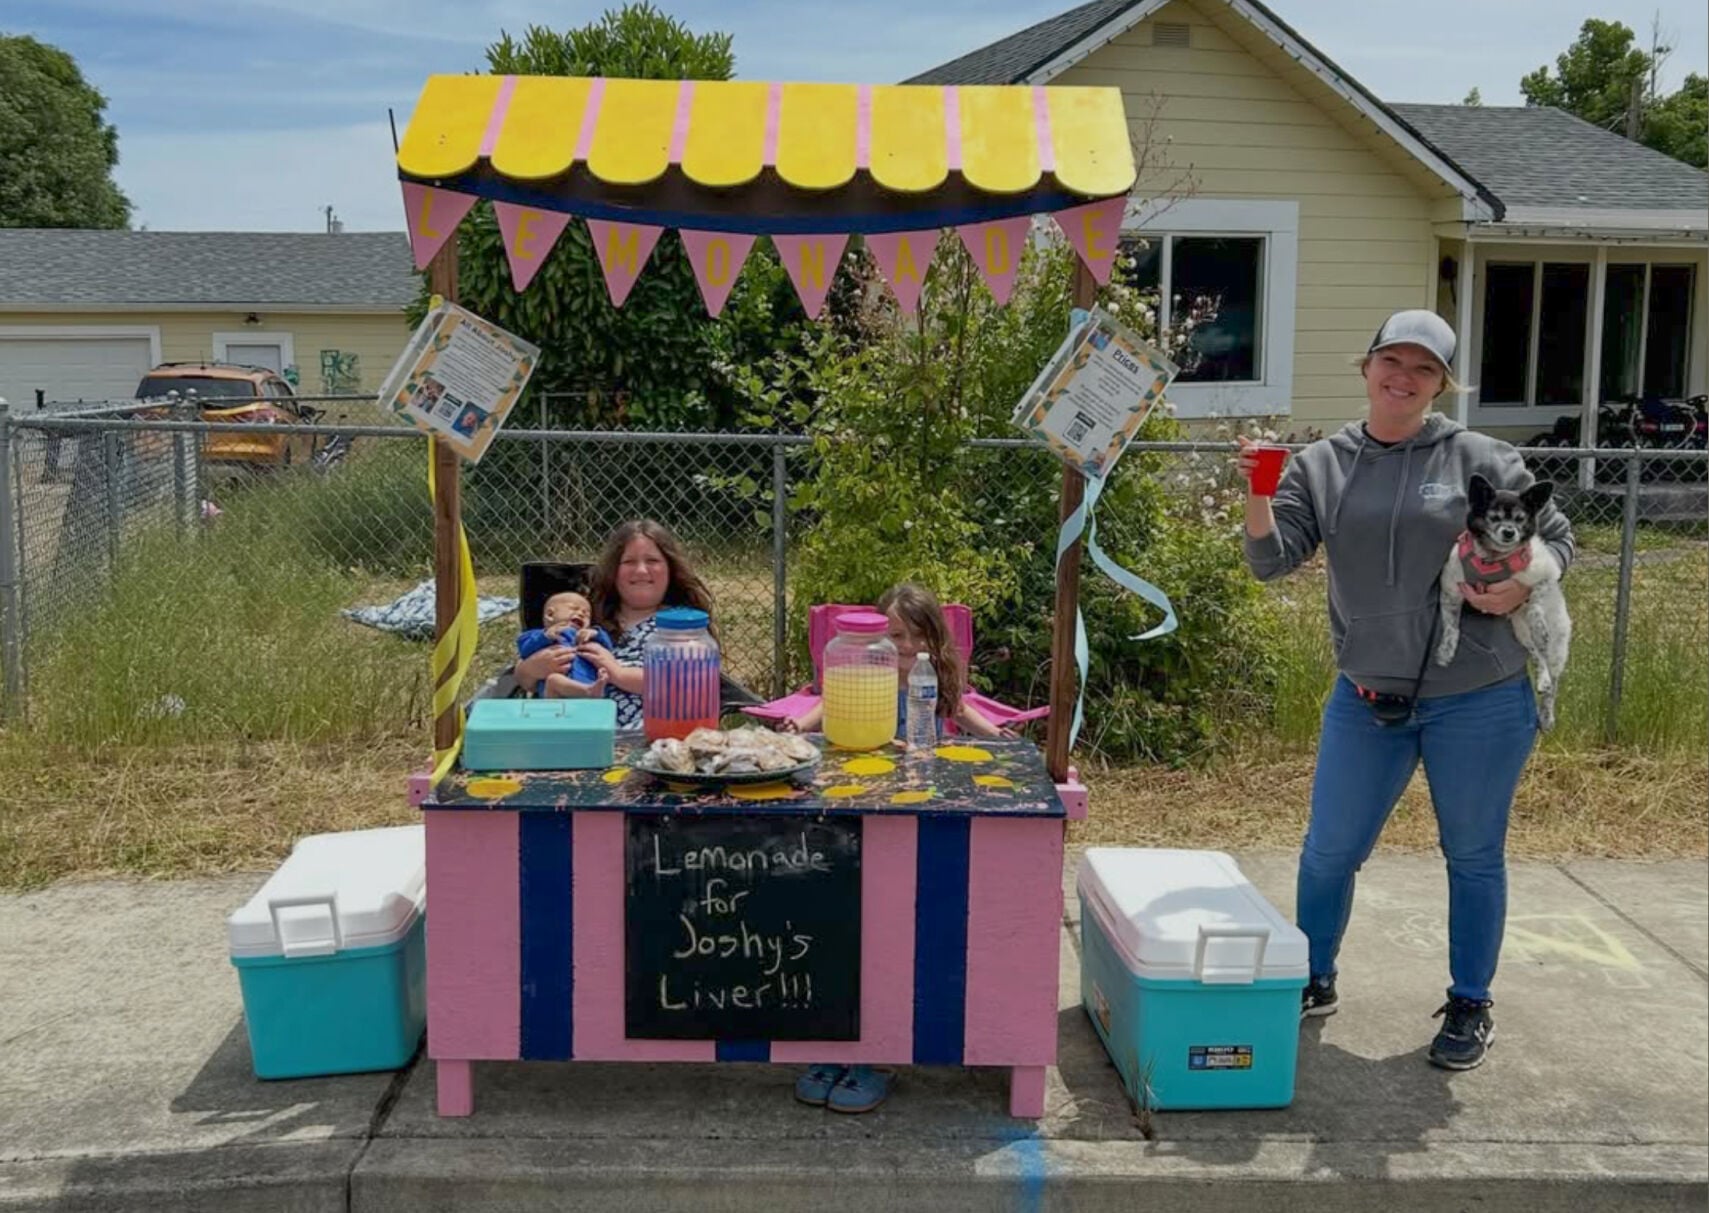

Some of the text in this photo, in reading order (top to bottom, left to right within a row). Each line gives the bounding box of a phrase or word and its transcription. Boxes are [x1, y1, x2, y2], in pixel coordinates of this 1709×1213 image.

[417, 191, 1107, 289] LEMONADE
[654, 832, 832, 875] Lemonade
[701, 878, 749, 914] for
[674, 914, 813, 975] Joshy's
[660, 973, 812, 1009] Liver!!!
